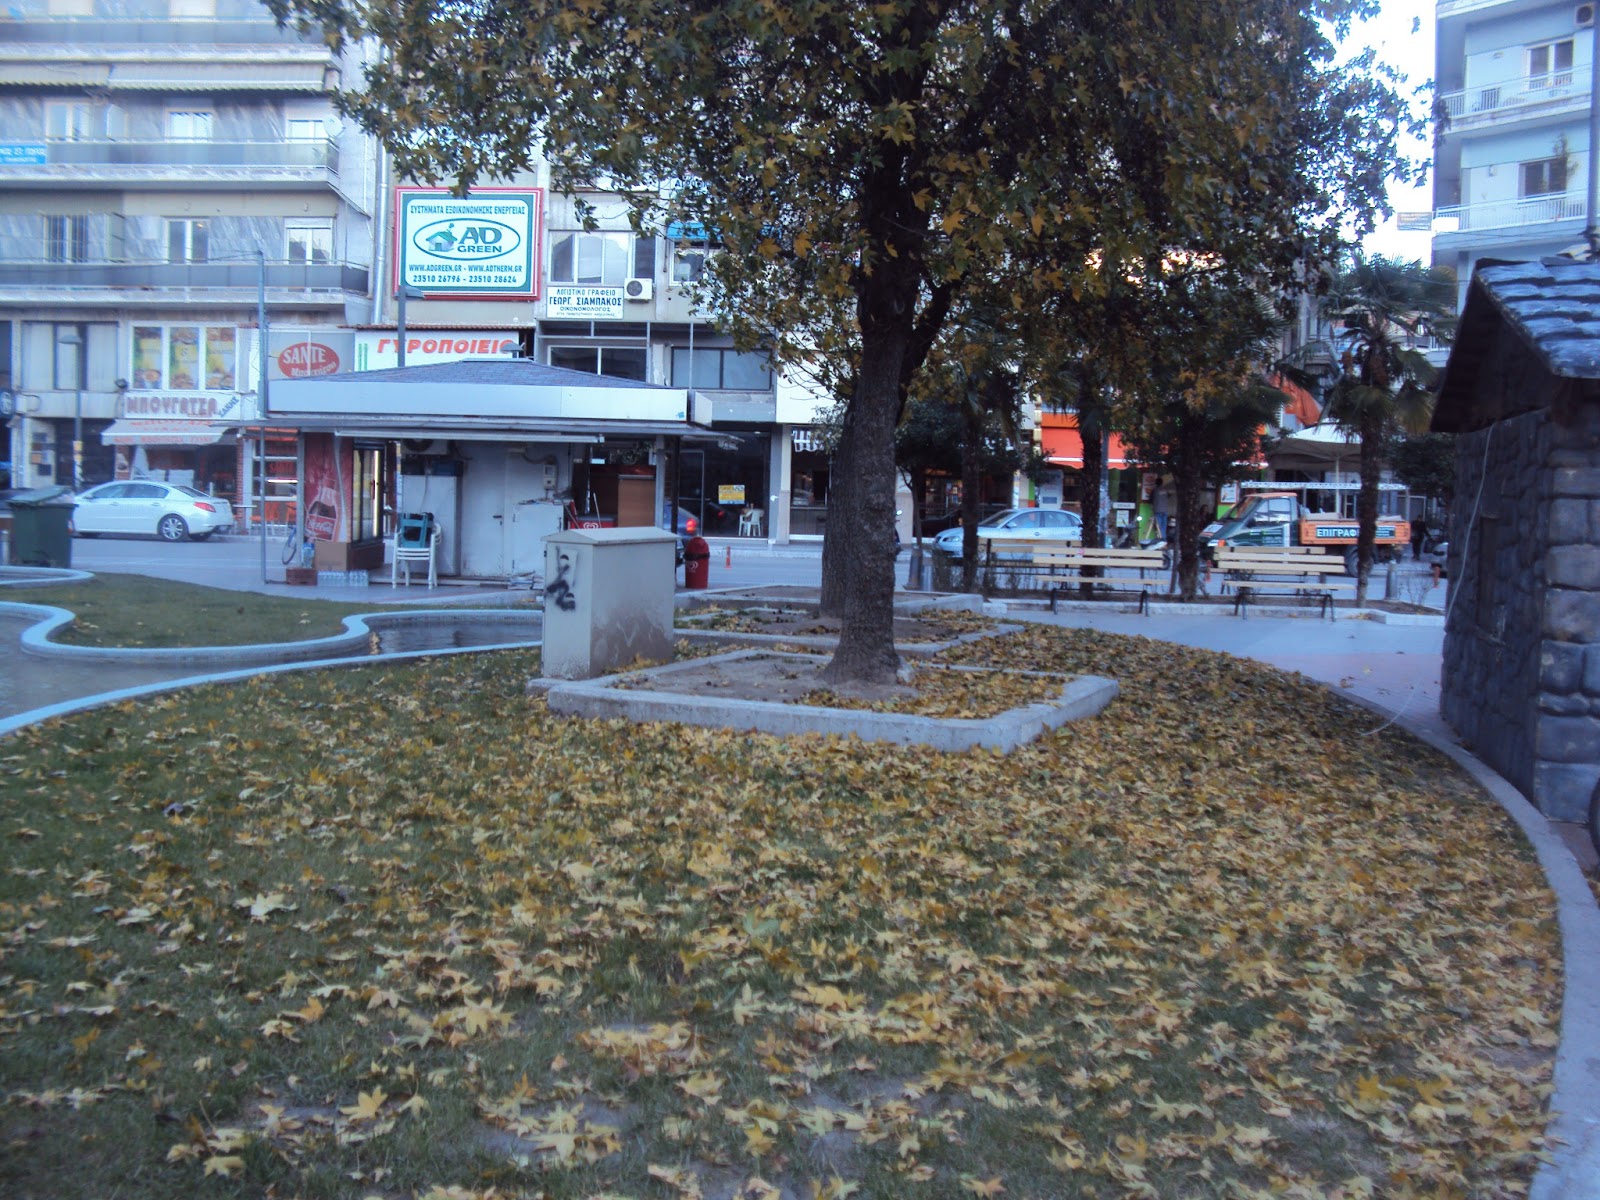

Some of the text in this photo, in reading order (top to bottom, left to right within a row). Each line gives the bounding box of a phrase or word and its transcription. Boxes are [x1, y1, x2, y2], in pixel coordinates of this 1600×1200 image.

[410, 205, 525, 215] ΣΥΣΤΗΜΑΤΑ ΕΞΟΙΚΟΝΟΜΗΣΗΣ ΕΝΕΡΓΕΙΑΣ
[458, 227, 502, 244] AD
[457, 245, 502, 253] GREEN
[409, 264, 462, 272] WWW.ADGREEN.GR
[468, 265, 523, 273] WWW.ADTHERM.GR
[437, 275, 461, 283] 26796
[468, 275, 492, 283] 23510
[493, 275, 517, 283] 28624
[576, 297, 622, 306] ΣΙΑΜΠΑΚΟΣ
[282, 345, 326, 364] SANTE
[126, 396, 218, 414] ΜΠΟΥΓΑΤΣΑ
